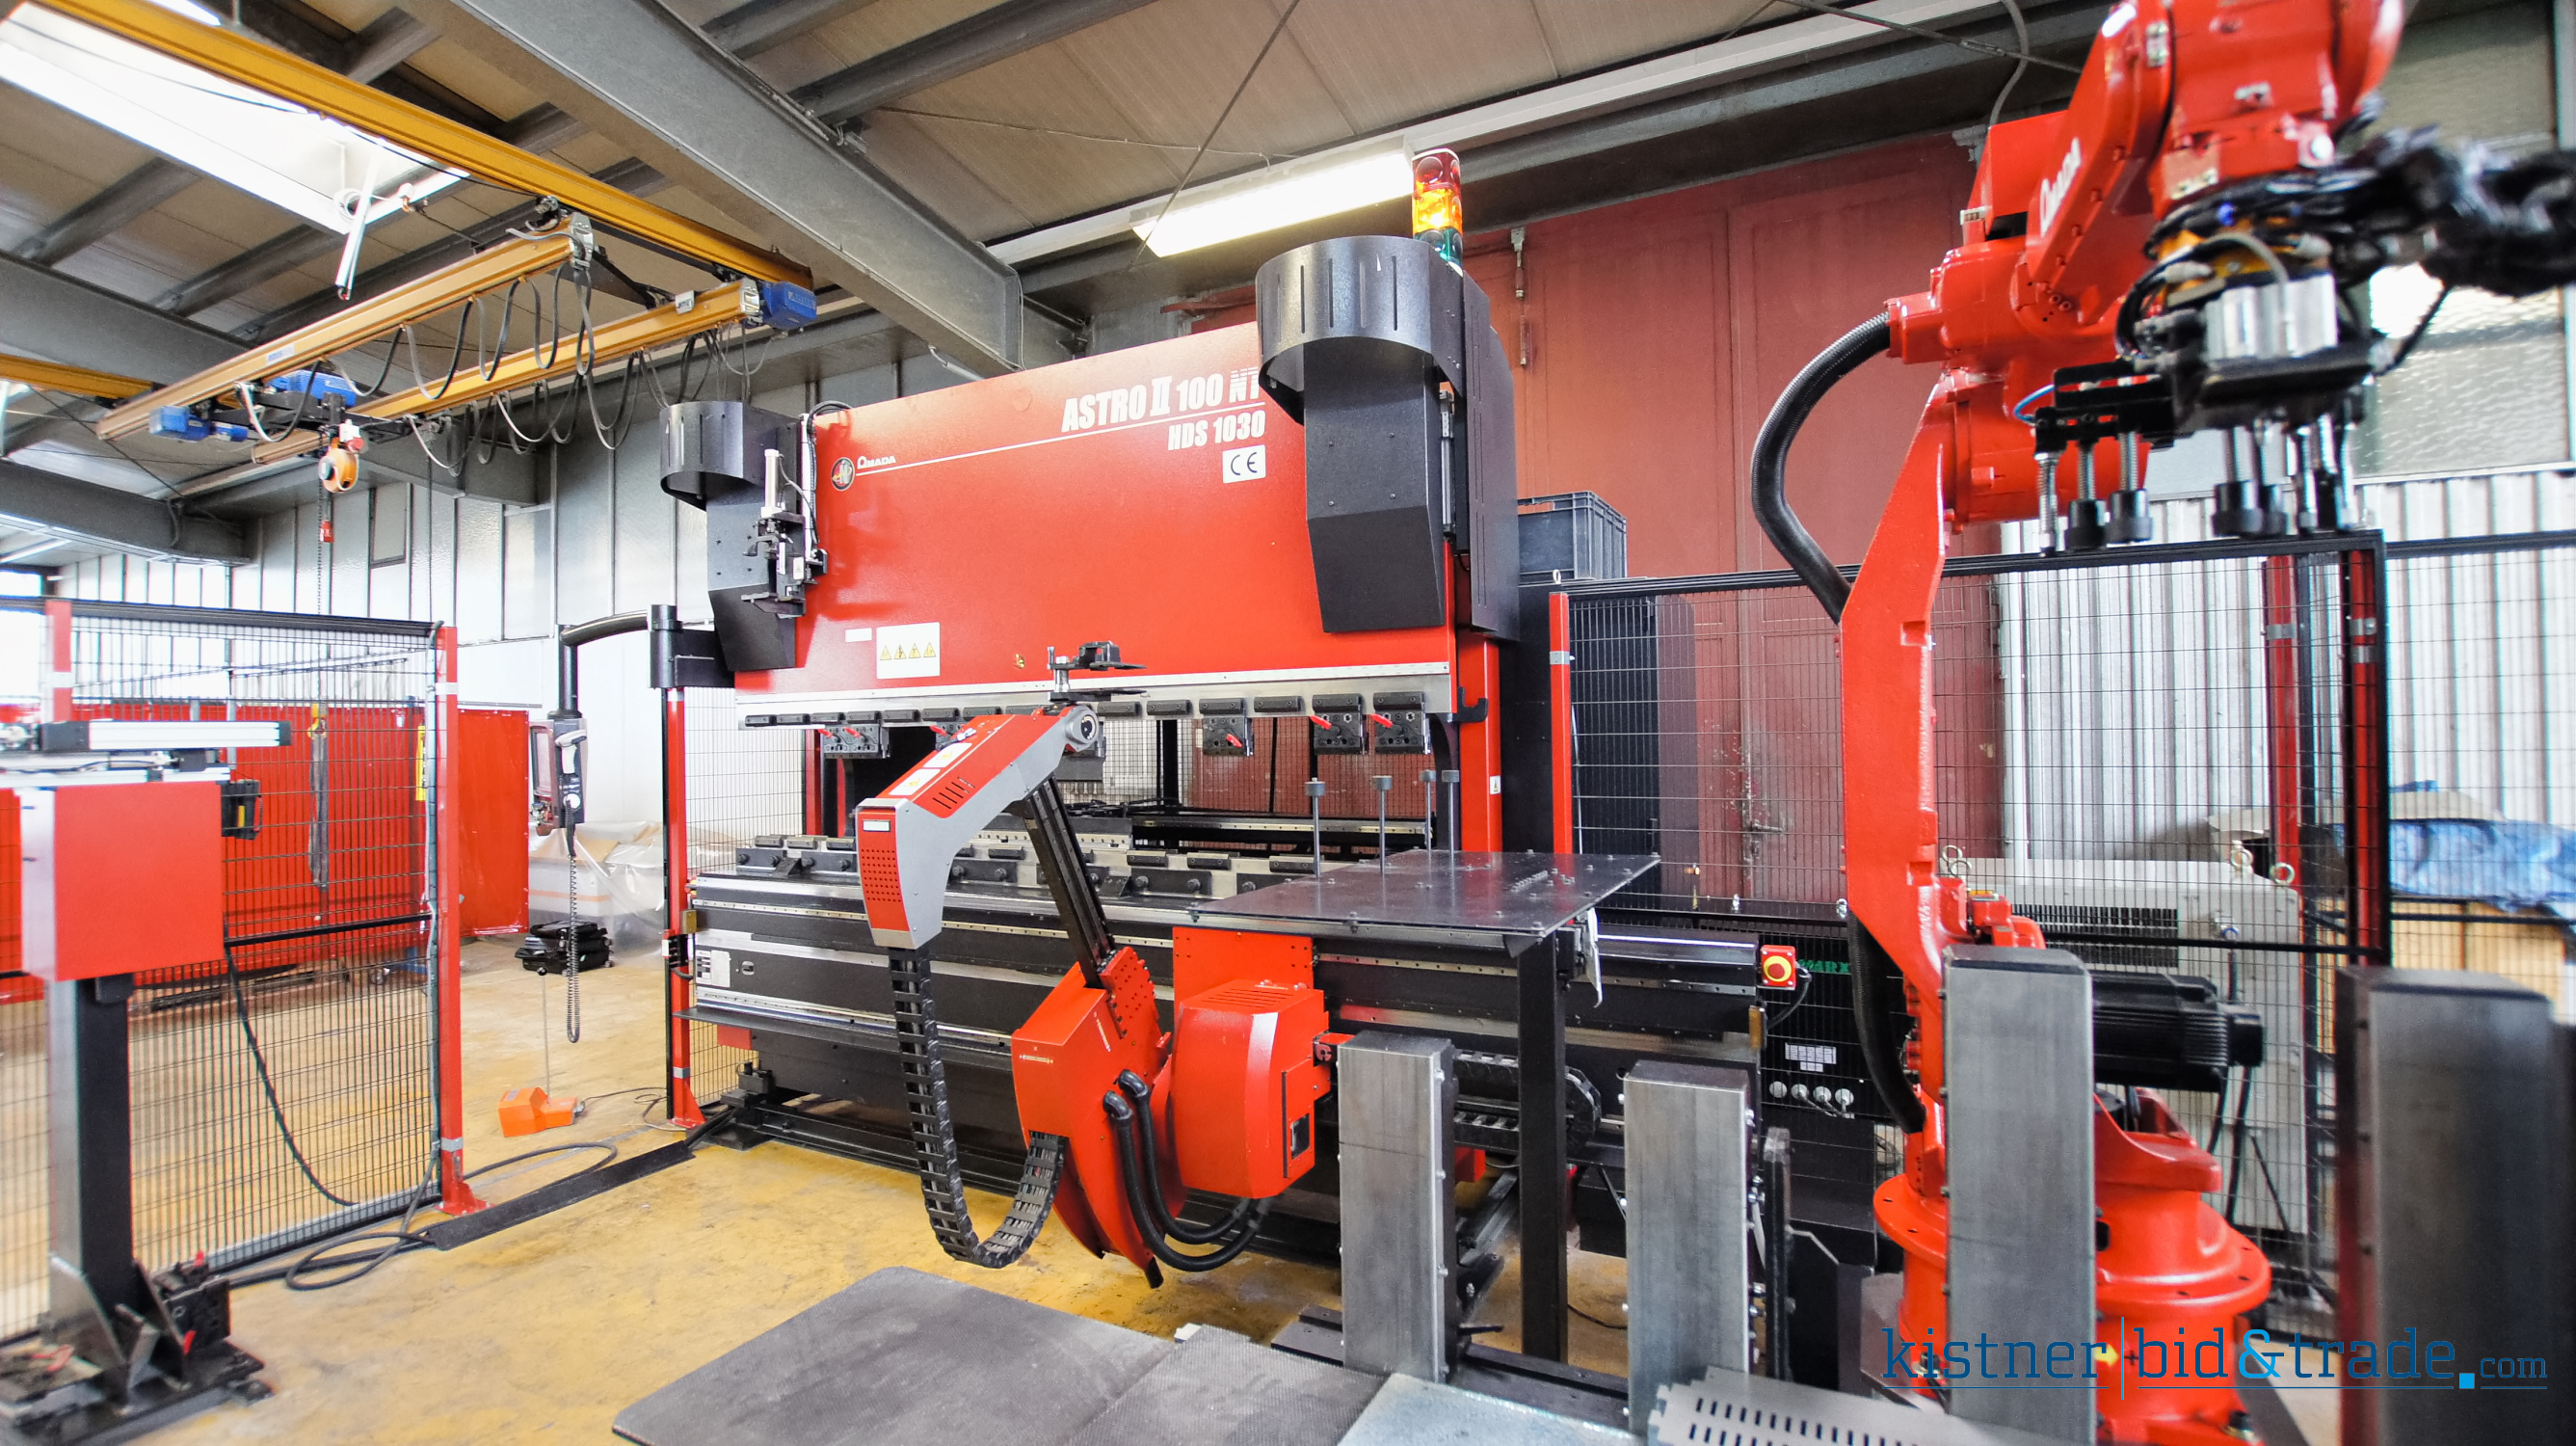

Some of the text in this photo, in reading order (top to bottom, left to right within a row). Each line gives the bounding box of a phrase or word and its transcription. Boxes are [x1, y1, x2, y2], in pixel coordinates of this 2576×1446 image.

[1061, 384, 1147, 433] ASTRO
[1176, 373, 1224, 413] 100
[1167, 410, 1266, 451] HDS 1030
[1230, 451, 1258, 476] CE
